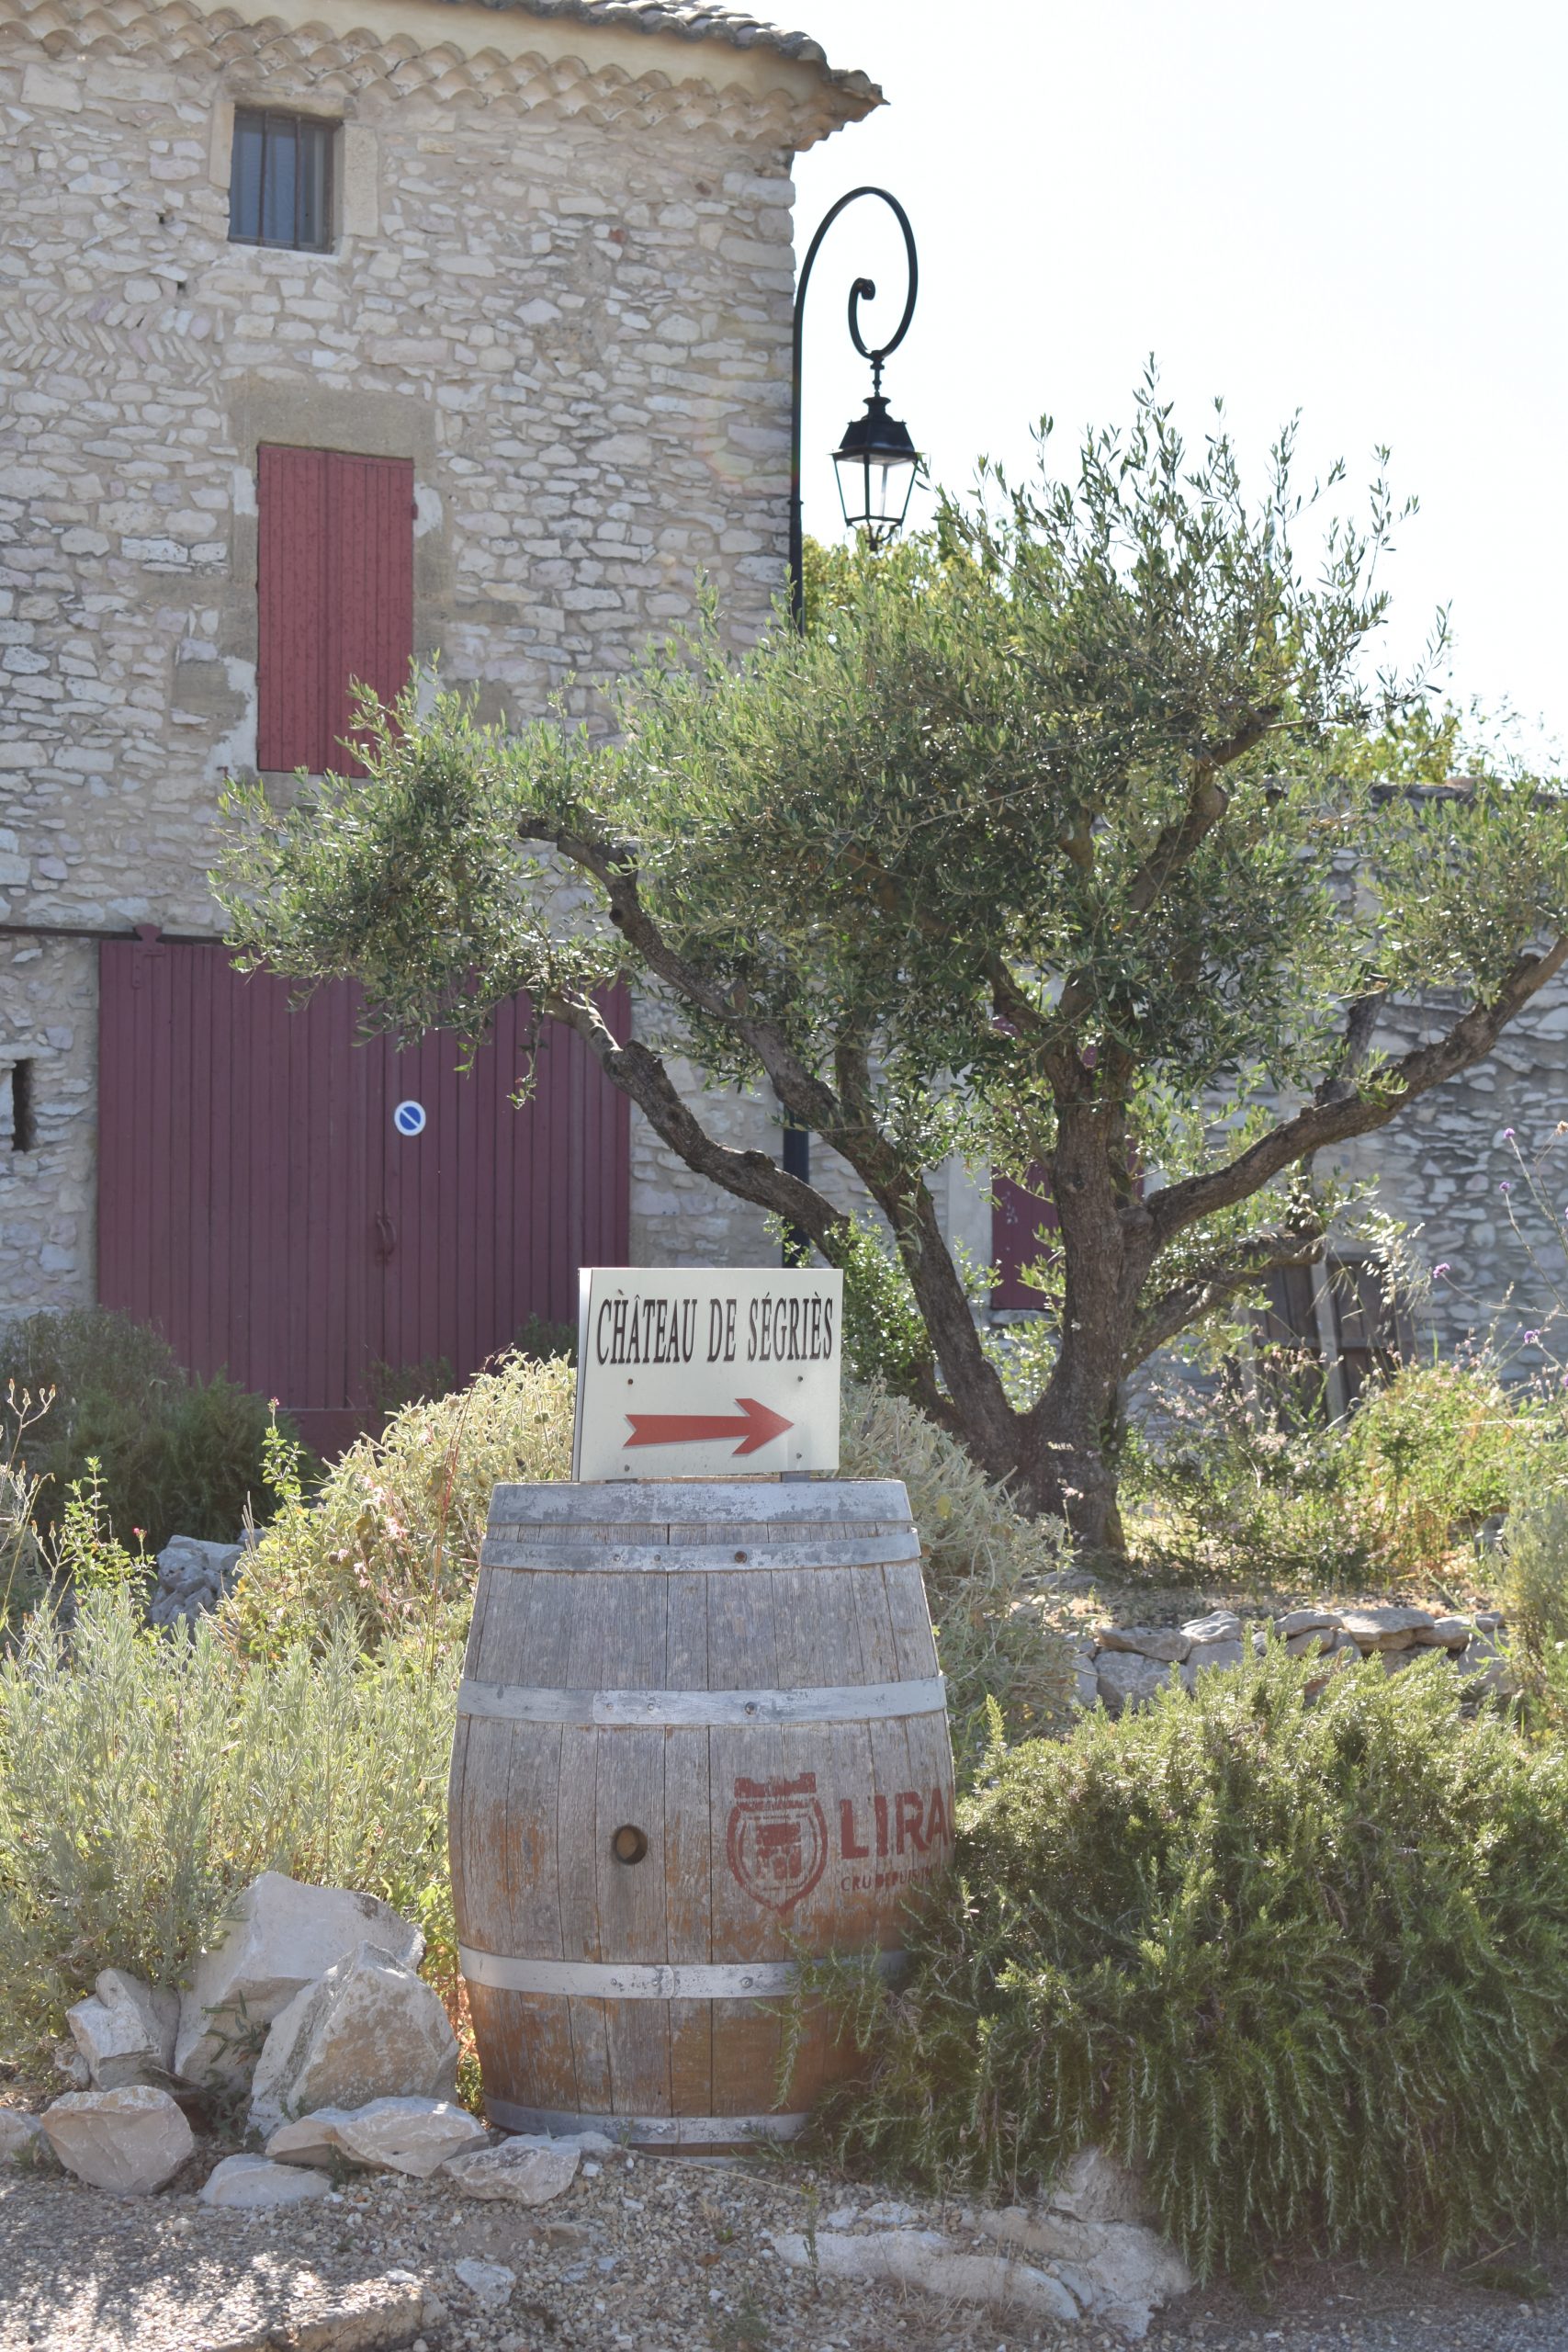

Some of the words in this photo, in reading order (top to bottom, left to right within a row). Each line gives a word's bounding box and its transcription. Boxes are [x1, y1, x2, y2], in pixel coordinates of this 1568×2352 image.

[598, 1294, 697, 1364] CHÂTEAU
[707, 1298, 737, 1362] DE
[748, 1292, 833, 1361] SÉGRIÈS
[840, 1875, 871, 1891] CRU
